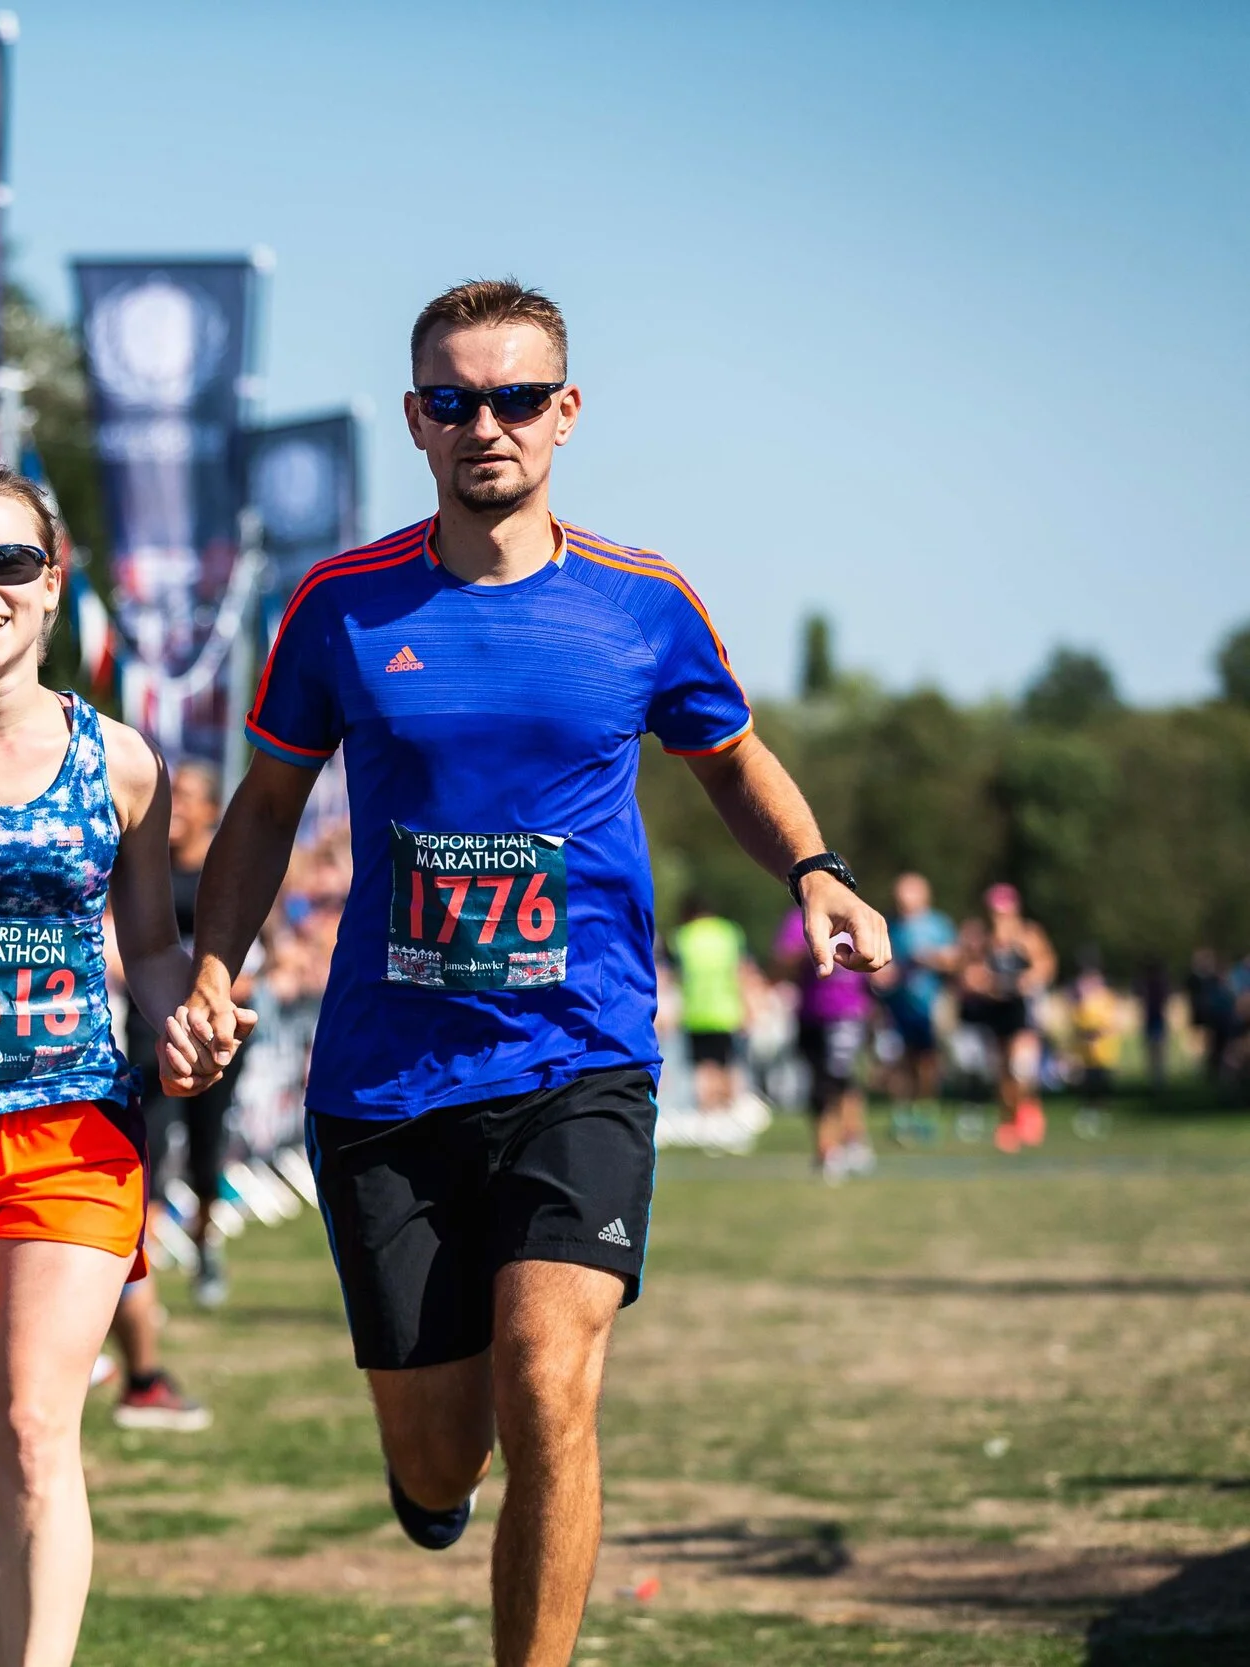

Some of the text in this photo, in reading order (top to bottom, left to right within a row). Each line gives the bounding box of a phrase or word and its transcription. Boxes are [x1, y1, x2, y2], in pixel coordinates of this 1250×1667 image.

[385, 661, 425, 673] adidas
[494, 834, 534, 849] HALF
[416, 847, 537, 870] MARATHON
[410, 871, 556, 944] 1776
[26, 928, 64, 945] HALF
[443, 960, 505, 972] james lawler
[4, 1052, 31, 1062] lawler
[597, 1231, 631, 1248] adidas
